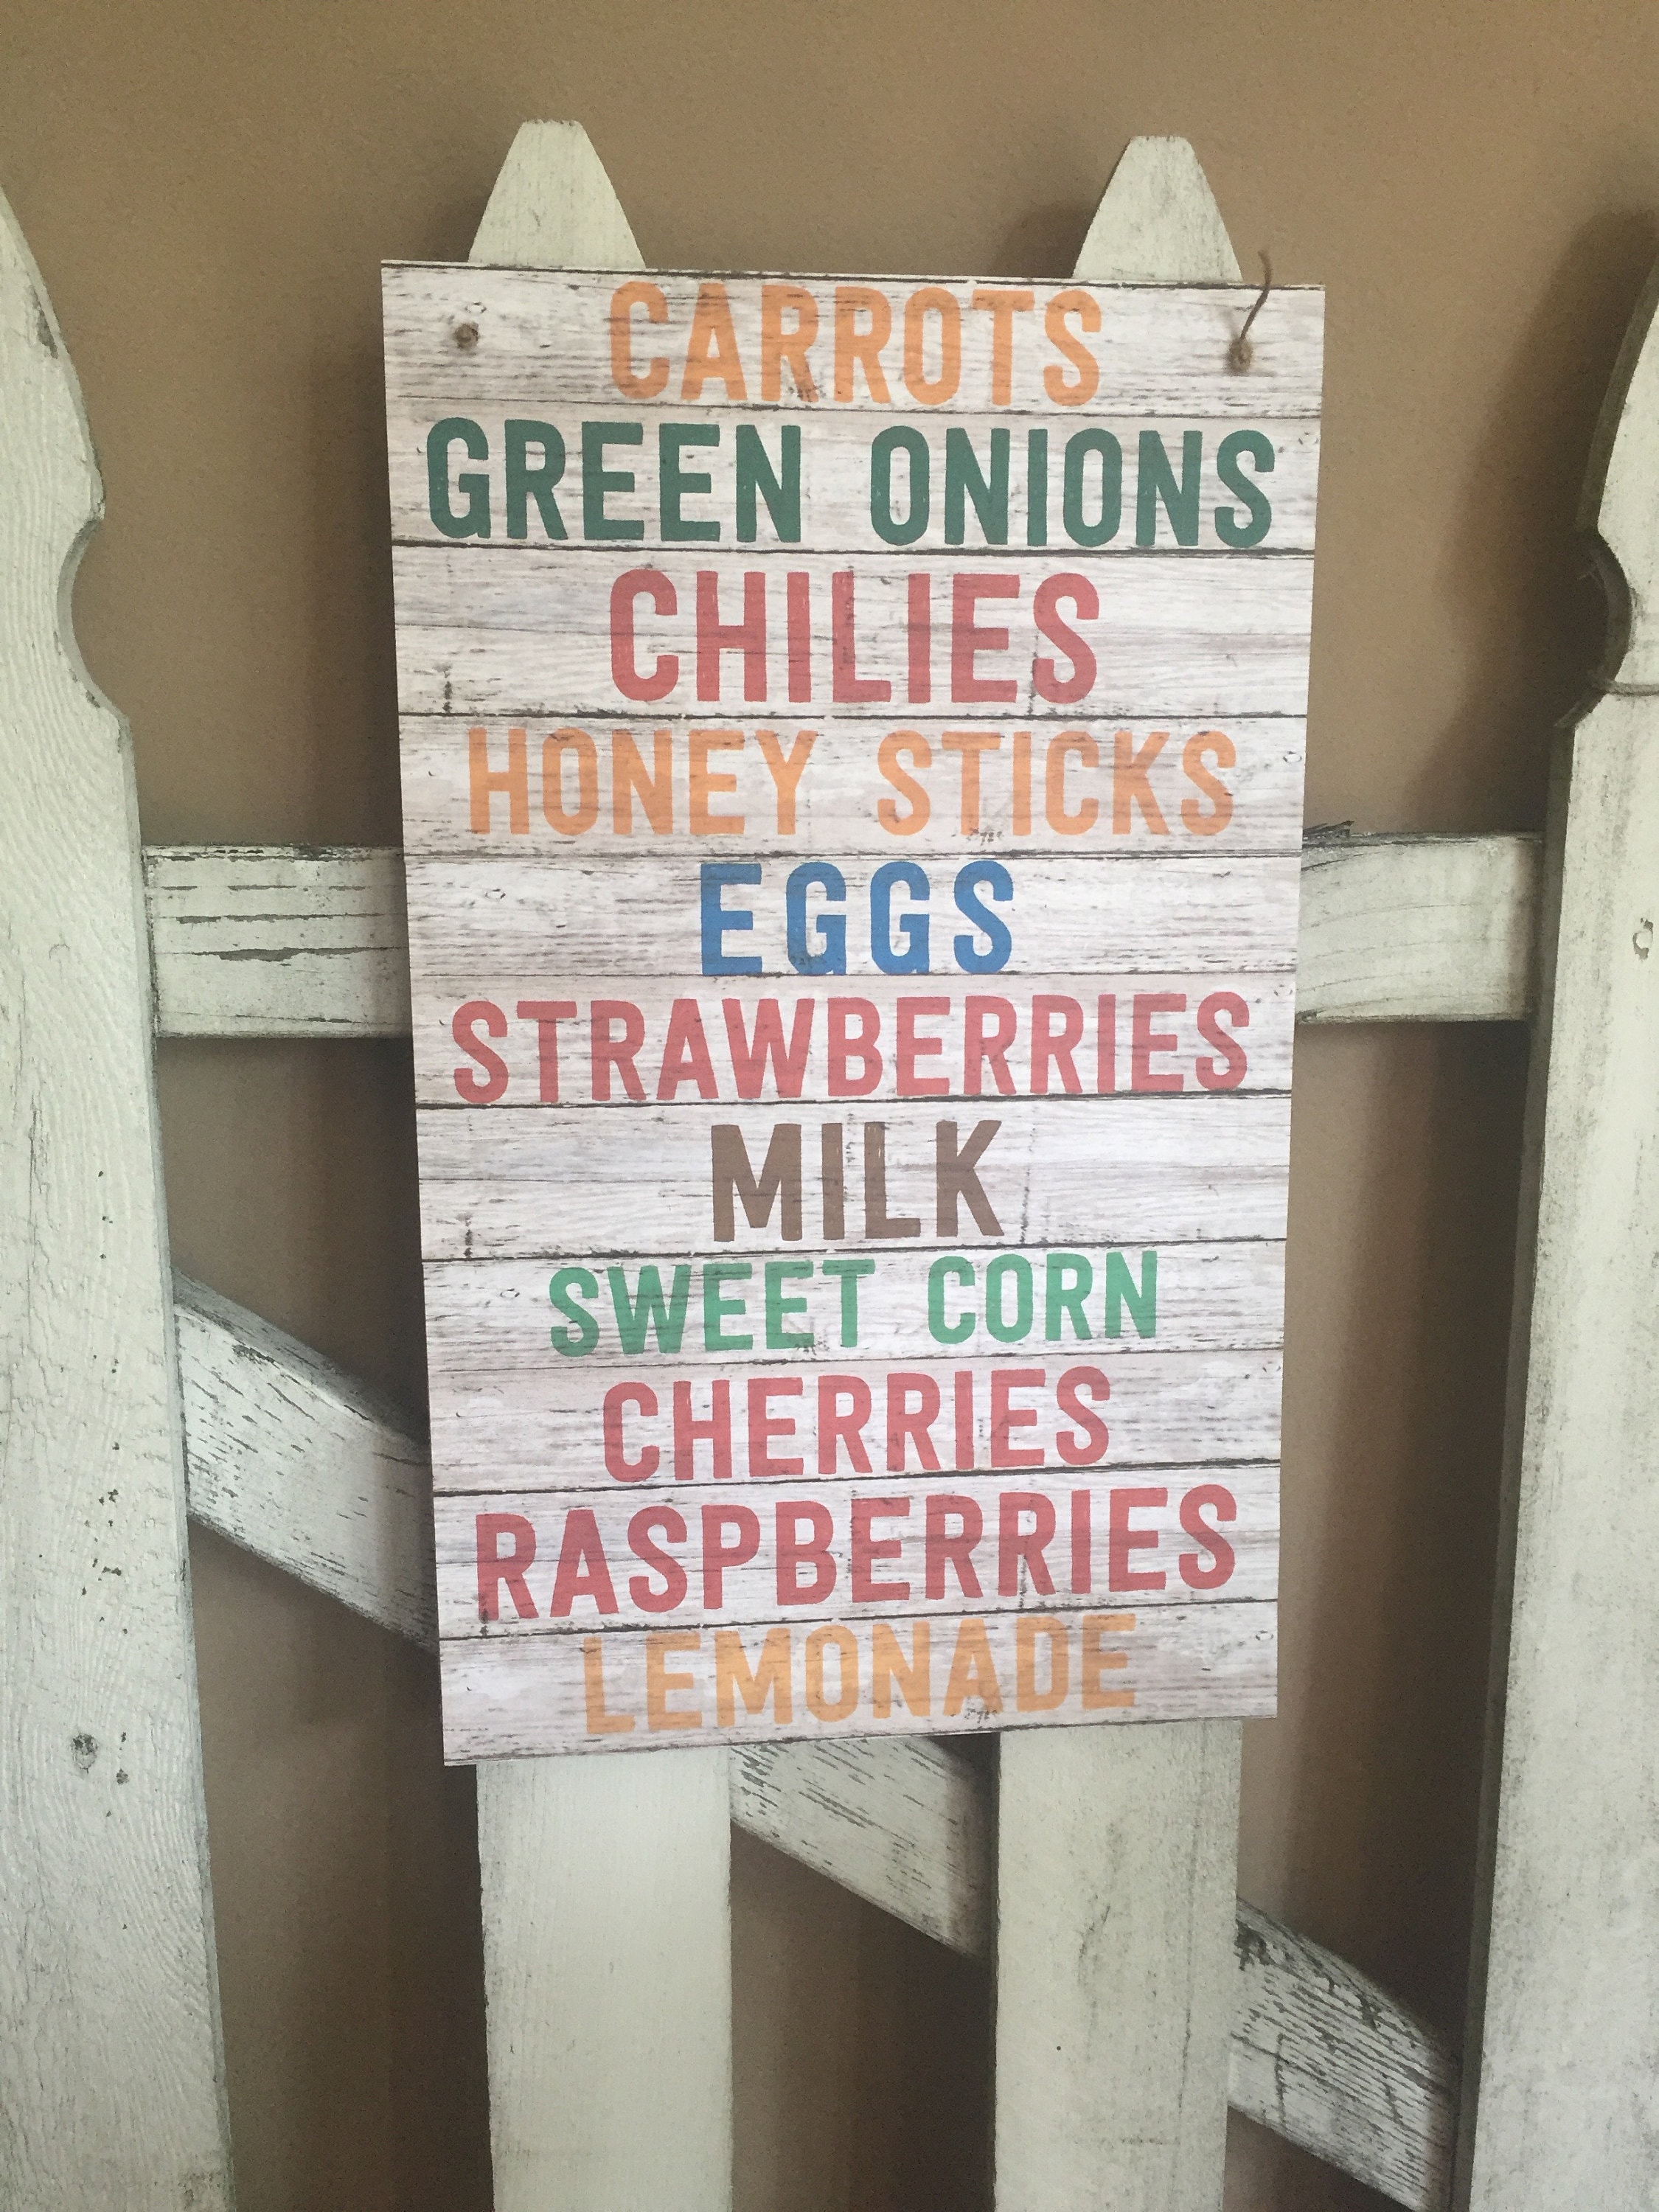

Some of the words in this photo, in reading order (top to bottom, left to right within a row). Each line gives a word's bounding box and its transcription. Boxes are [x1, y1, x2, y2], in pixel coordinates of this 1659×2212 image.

[610, 284, 1102, 406] CARROTS
[427, 419, 802, 545] GREEN
[871, 427, 1276, 549] ONIONS
[611, 570, 1098, 703] CHILIES
[469, 728, 816, 835] HONEY
[878, 731, 1235, 835] STICKS
[702, 861, 1012, 973] EGGS
[453, 992, 1248, 1102] STRAWBERRIES
[712, 1120, 1004, 1242] MILK
[549, 1259, 874, 1357] SWEET
[929, 1250, 1157, 1343] CORN
[605, 1367, 1108, 1482] CHERRIES
[477, 1485, 1237, 1621] RASPBERRIES
[585, 1615, 1135, 1733] LEMONADE
